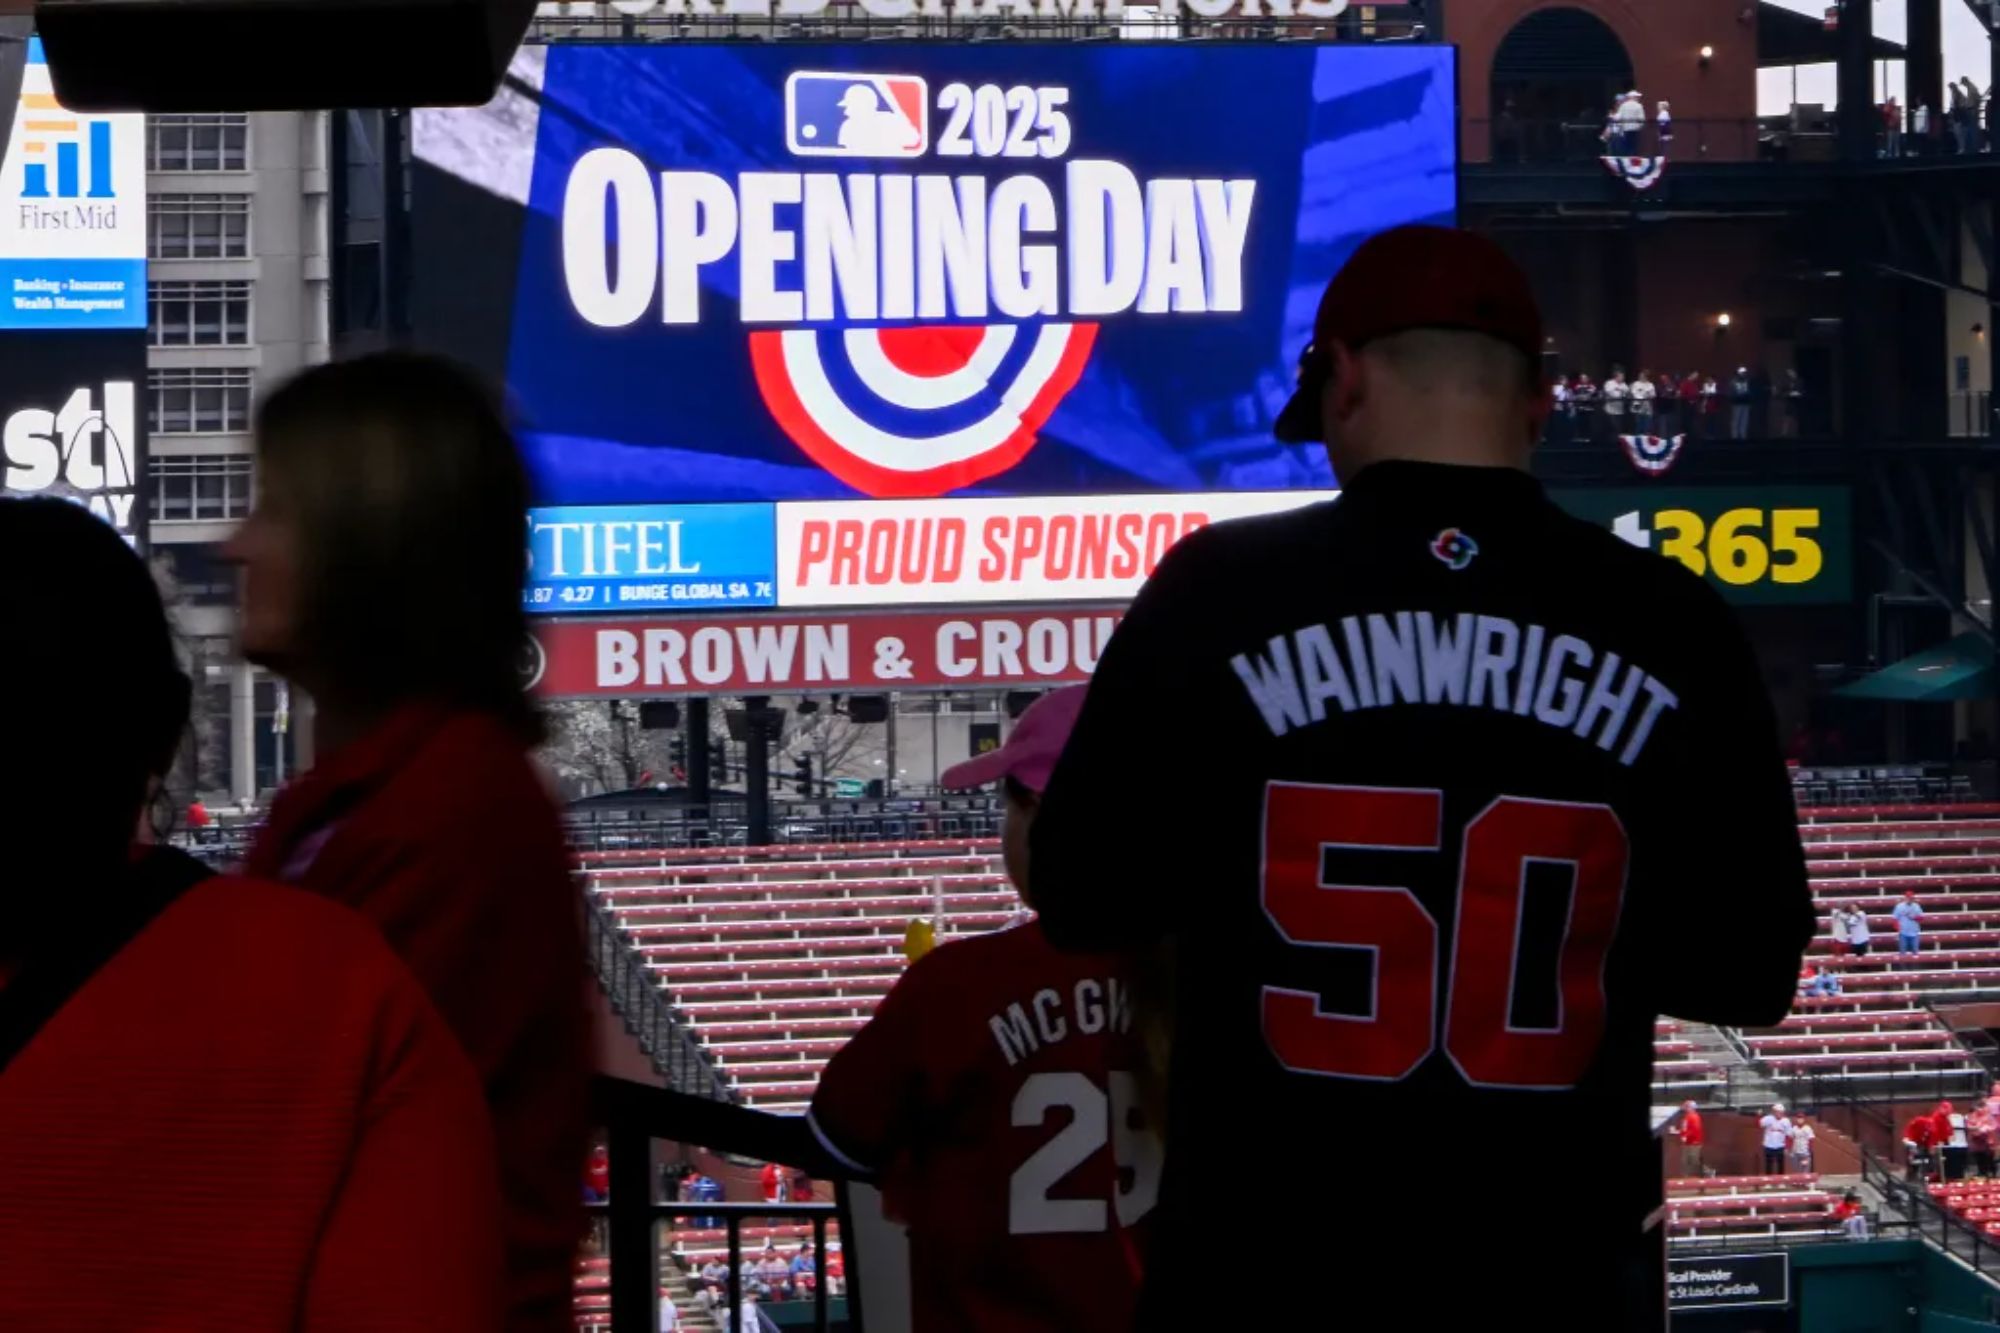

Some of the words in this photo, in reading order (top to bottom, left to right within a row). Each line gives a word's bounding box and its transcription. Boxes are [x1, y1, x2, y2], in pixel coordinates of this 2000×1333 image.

[937, 83, 1071, 158] 2025
[562, 147, 1058, 327] OPENING
[1066, 160, 1256, 316] DAY
[3, 381, 135, 491] stl
[796, 517, 967, 587] PROUD
[977, 512, 1210, 582] SPONSO
[618, 585, 669, 602] BUNGE
[670, 583, 728, 600] GLOBAL
[727, 581, 750, 598] SA
[596, 625, 850, 687] BROWN
[872, 636, 914, 680] &
[935, 616, 1123, 678] CROU
[1230, 611, 1680, 766] WAINWRIGHT
[1259, 779, 1630, 1090] 50
[1009, 1069, 1166, 1235] 25
[1690, 1269, 1733, 1282] Provider
[1690, 1285, 1714, 1297] Louis
[1715, 1283, 1760, 1297] Cardinals
